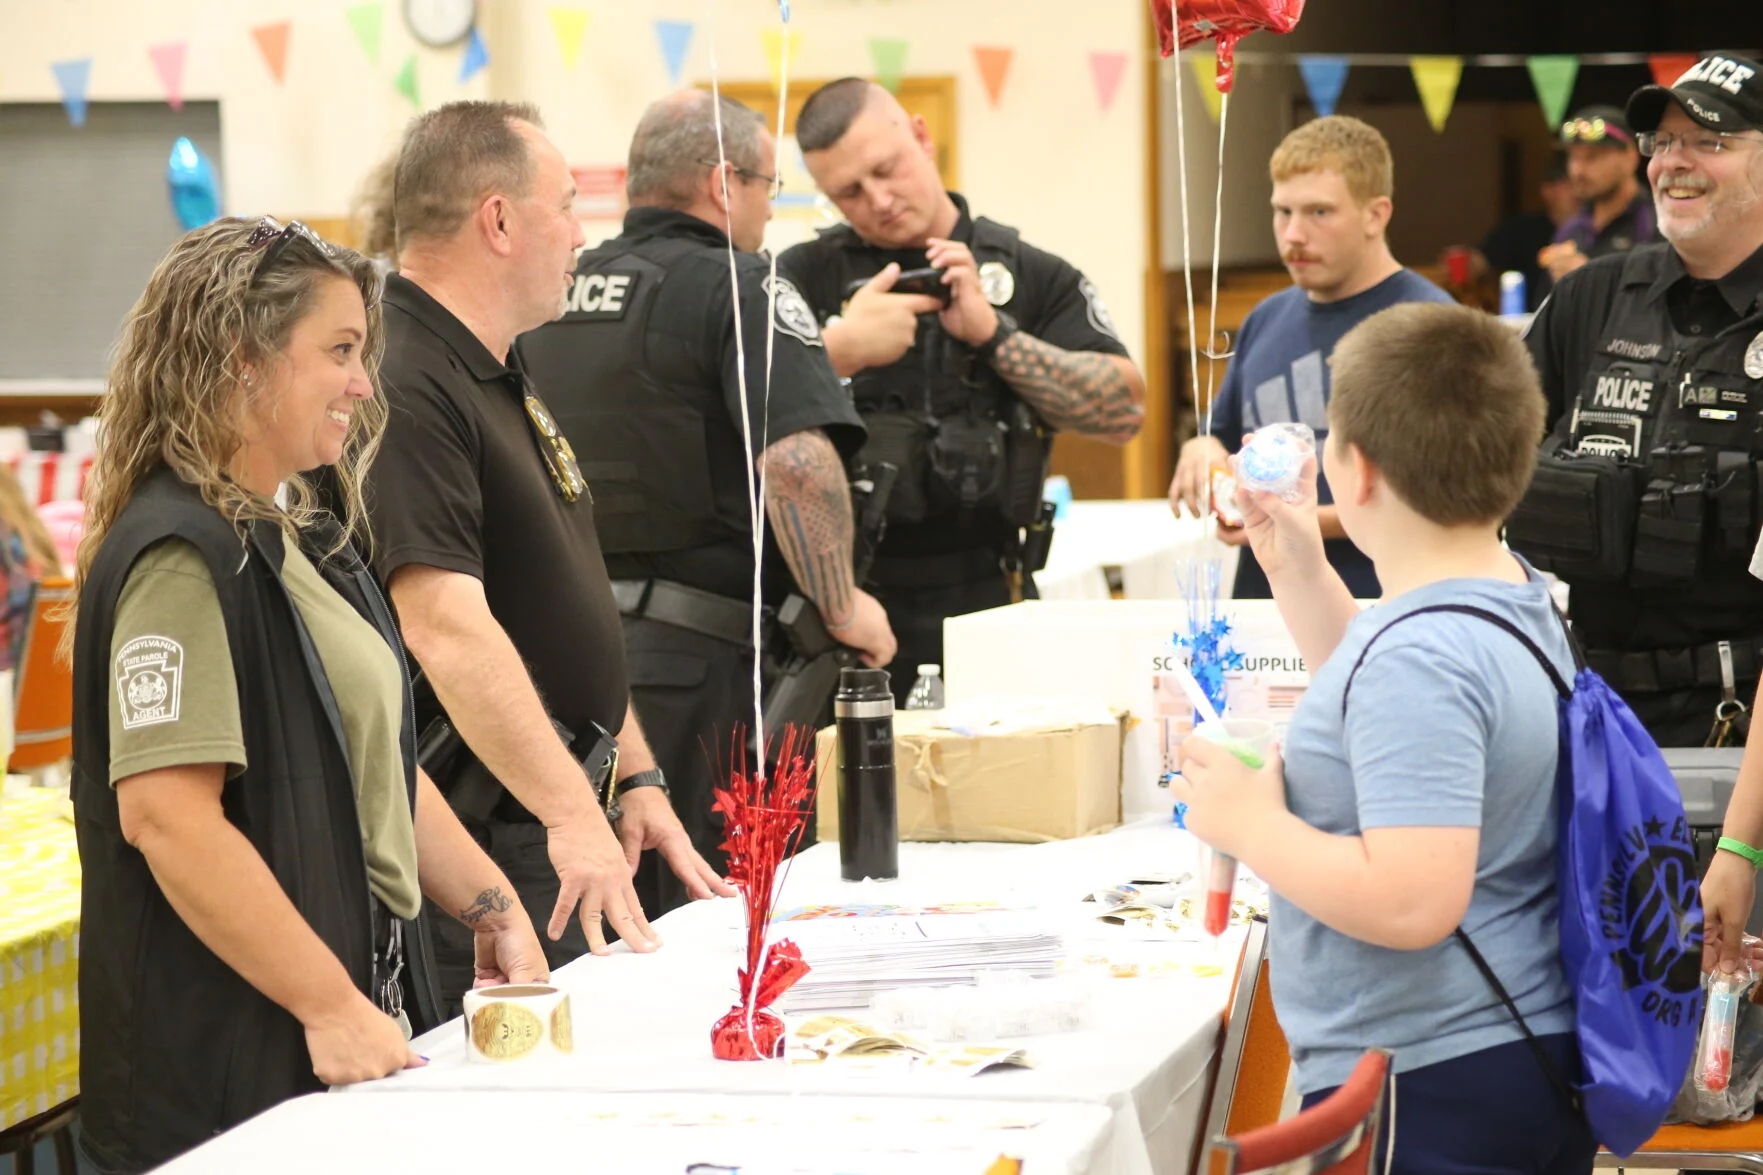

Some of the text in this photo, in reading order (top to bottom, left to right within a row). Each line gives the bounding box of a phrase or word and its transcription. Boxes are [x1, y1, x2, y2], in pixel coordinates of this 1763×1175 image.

[1687, 97, 1720, 122] POLICE
[1593, 376, 1654, 411] POLICE
[118, 640, 177, 662] PENNSYLVANIA
[123, 651, 168, 667] STATE PAROLE
[133, 706, 165, 721] AGENT
